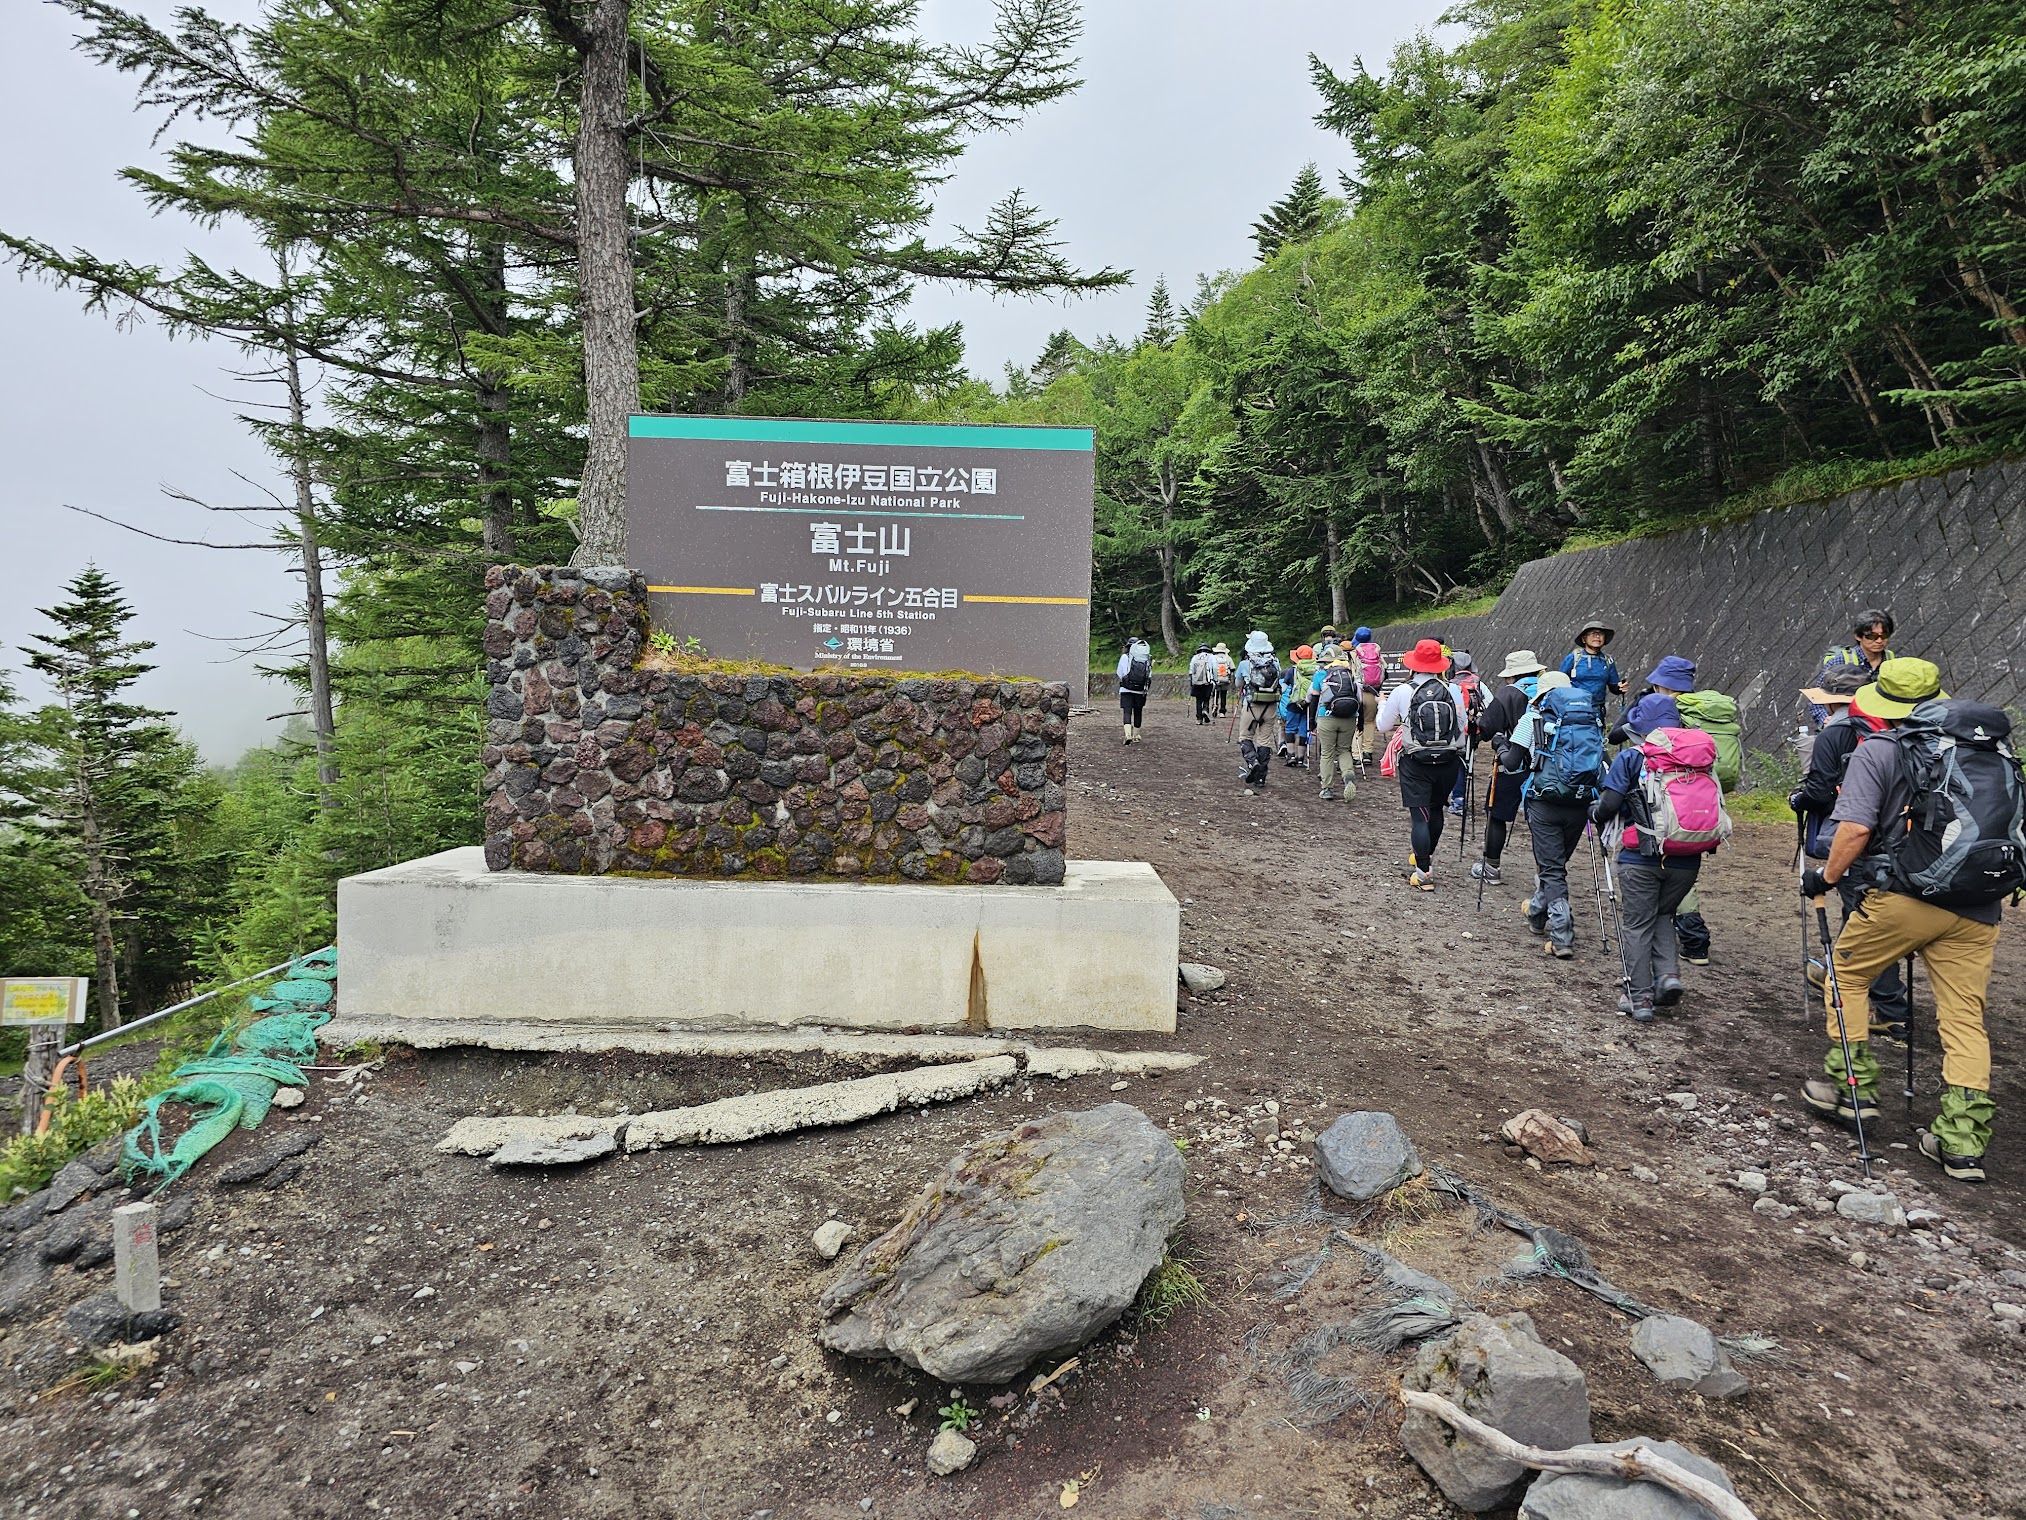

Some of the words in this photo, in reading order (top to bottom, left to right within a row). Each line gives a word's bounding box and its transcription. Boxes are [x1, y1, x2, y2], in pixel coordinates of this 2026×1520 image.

[725, 460, 997, 494] 富士箱根伊豆国立公園
[760, 491, 866, 506] Fuji-Hakone-Izu
[870, 495, 925, 508] National
[930, 496, 961, 509] Park
[809, 521, 911, 557] 富士山
[829, 558, 890, 577] Mt.Fuji
[760, 582, 958, 609] 富士スバルライン五合目
[782, 606, 846, 618] Fuji-Subaru
[850, 609, 874, 619] Line
[876, 610, 893, 619] 5th
[897, 610, 936, 620] Station
[846, 637, 895, 653] 環境省
[814, 652, 843, 661] Ministry
[863, 653, 903, 661] Environment
